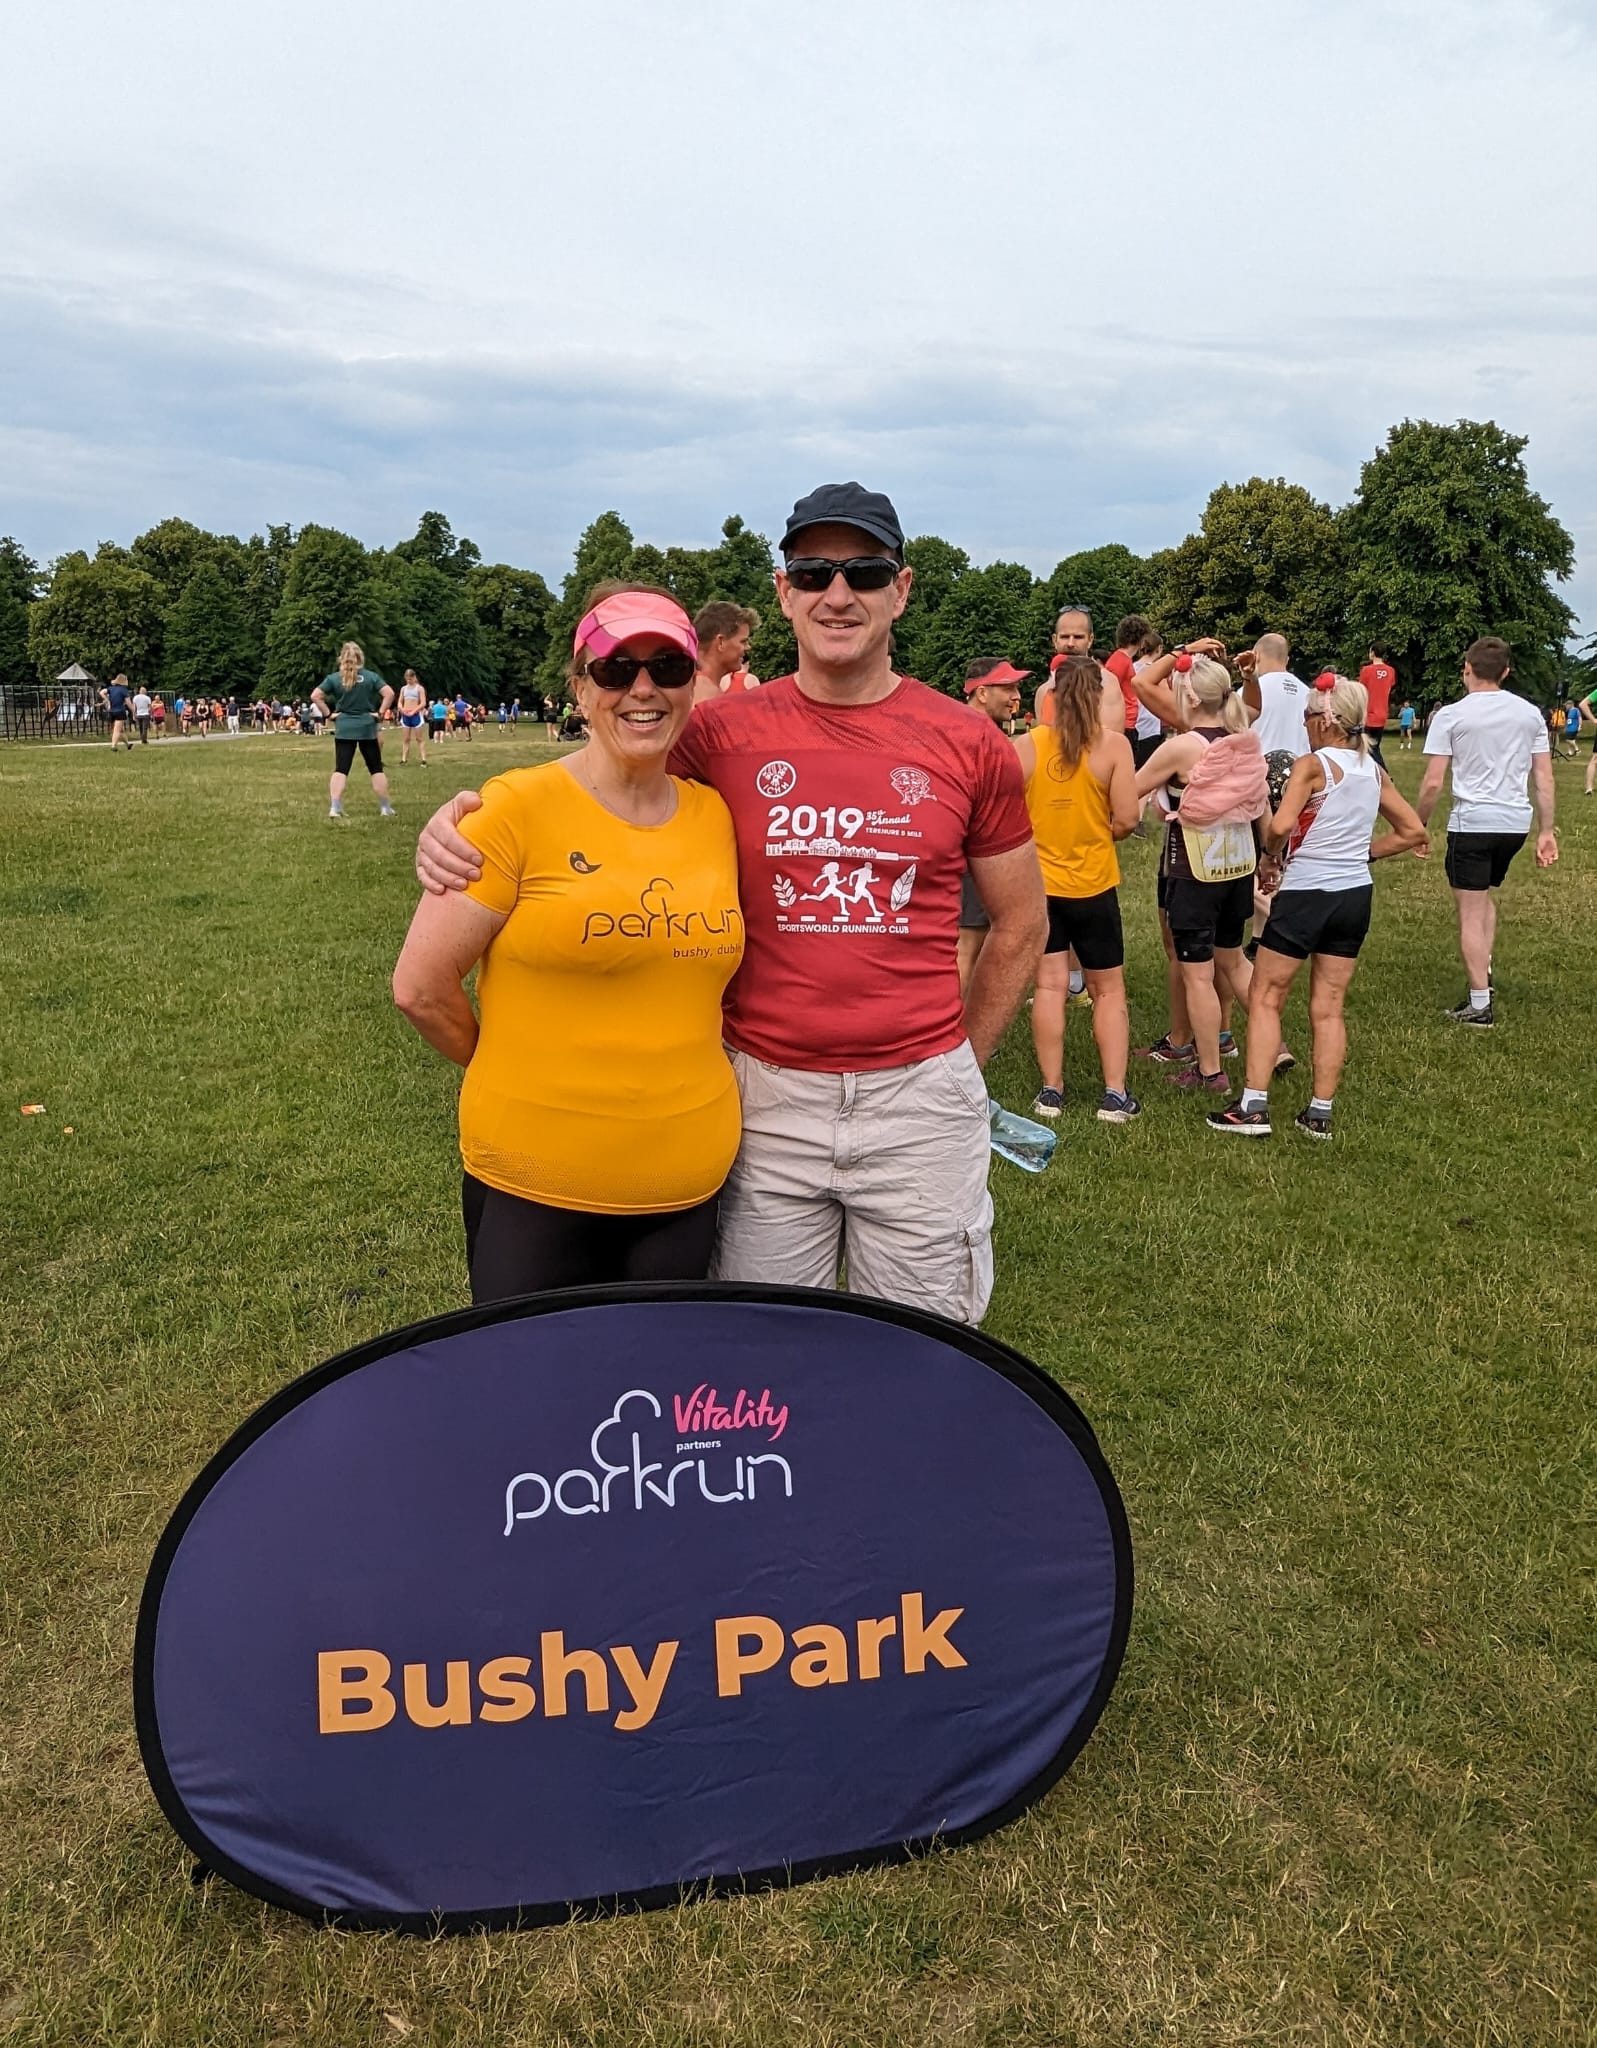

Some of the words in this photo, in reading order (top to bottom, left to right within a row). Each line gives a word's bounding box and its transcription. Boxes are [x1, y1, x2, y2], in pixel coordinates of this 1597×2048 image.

[1376, 669, 1388, 679] 50
[766, 804, 865, 839] 2019
[871, 813, 912, 826] Annual
[581, 877, 743, 944] parkrun
[777, 923, 840, 933] SPORTSWORLD
[841, 924, 887, 934] RUNNING
[888, 925, 910, 934] CLUB
[673, 945, 713, 958] bushy,
[717, 943, 743, 956] dubl
[673, 1383, 790, 1442] Vitality
[676, 1439, 722, 1454] partners
[504, 1389, 792, 1537] parkrun
[318, 1630, 679, 1734] Bushy
[715, 1592, 969, 1697] Park
